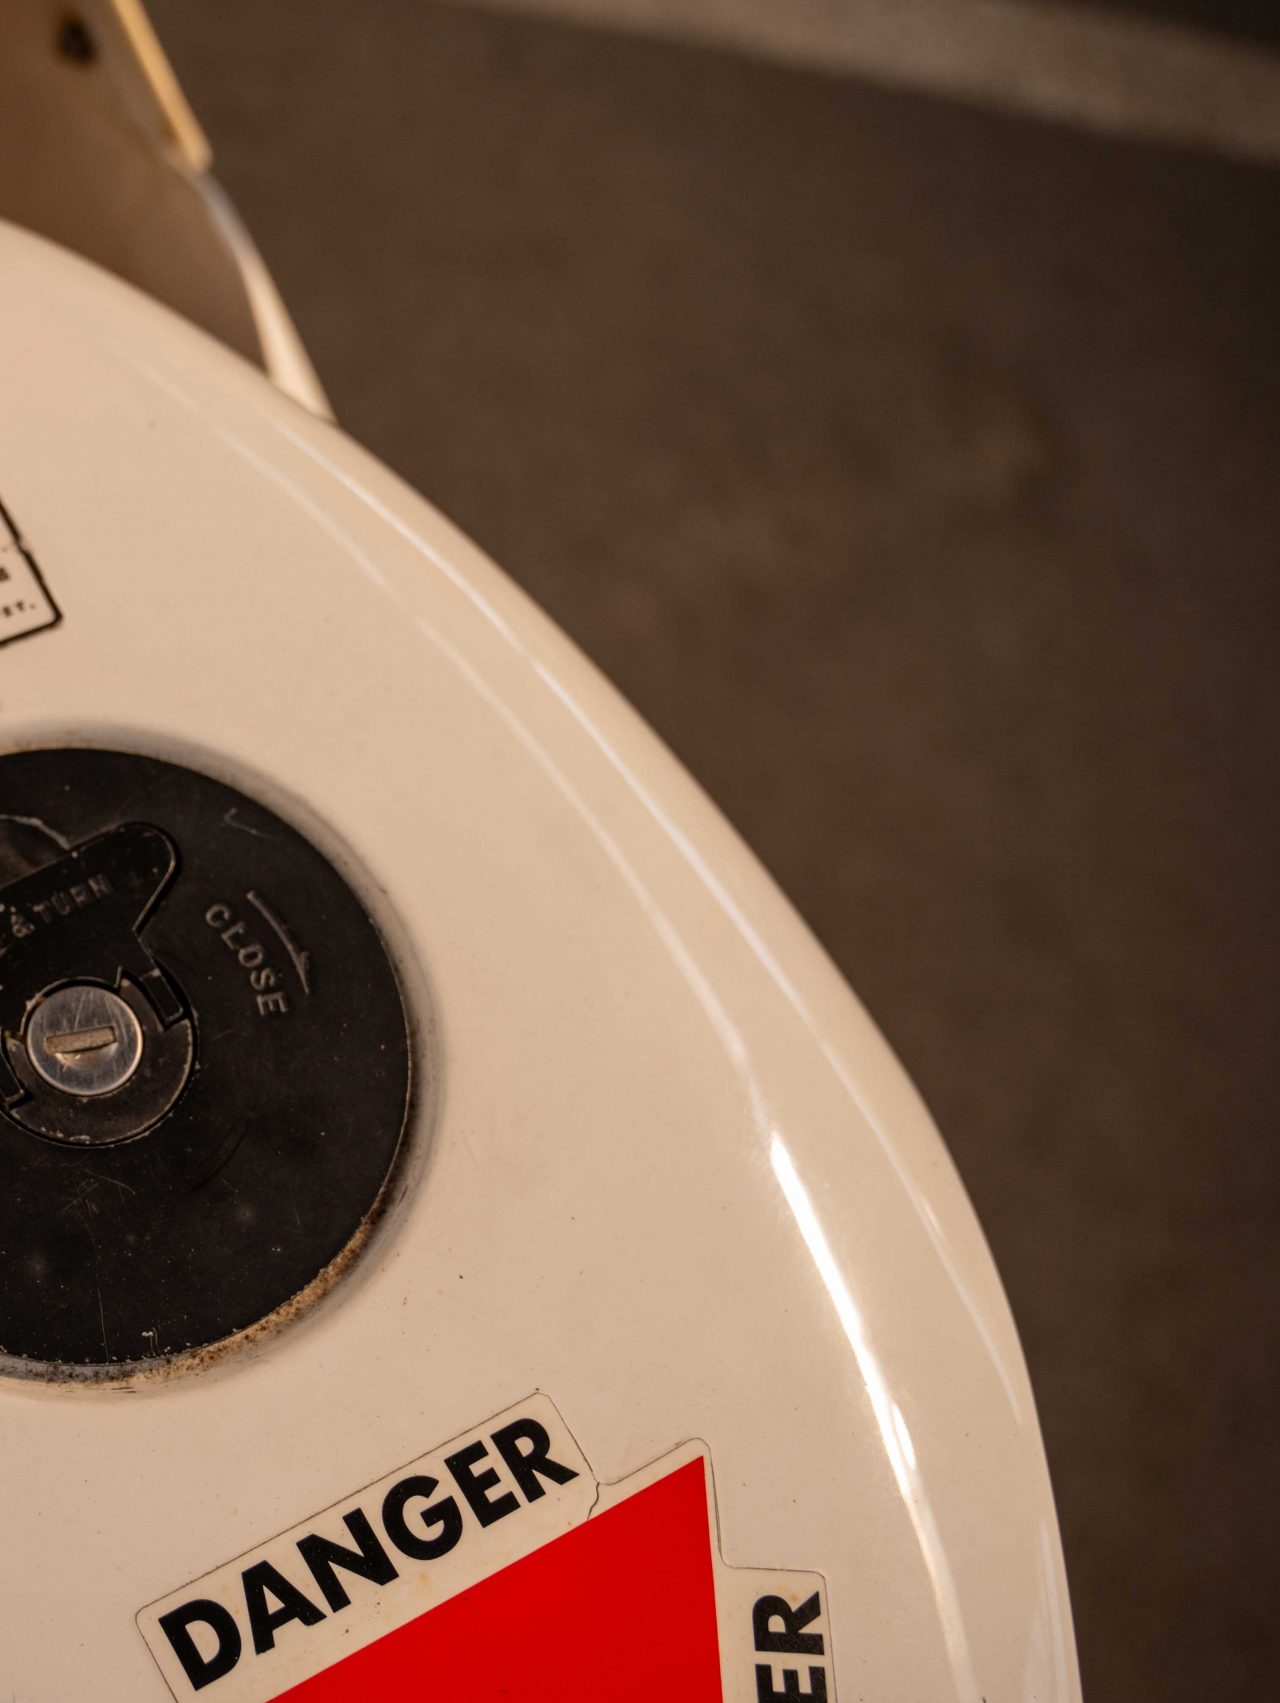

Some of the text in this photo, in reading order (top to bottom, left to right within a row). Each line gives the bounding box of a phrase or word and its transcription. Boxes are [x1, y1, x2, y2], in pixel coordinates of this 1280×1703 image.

[10, 905, 35, 938] &
[32, 874, 112, 924] TURN
[206, 903, 287, 1015] CLOSE
[158, 1417, 580, 1691] DANGER
